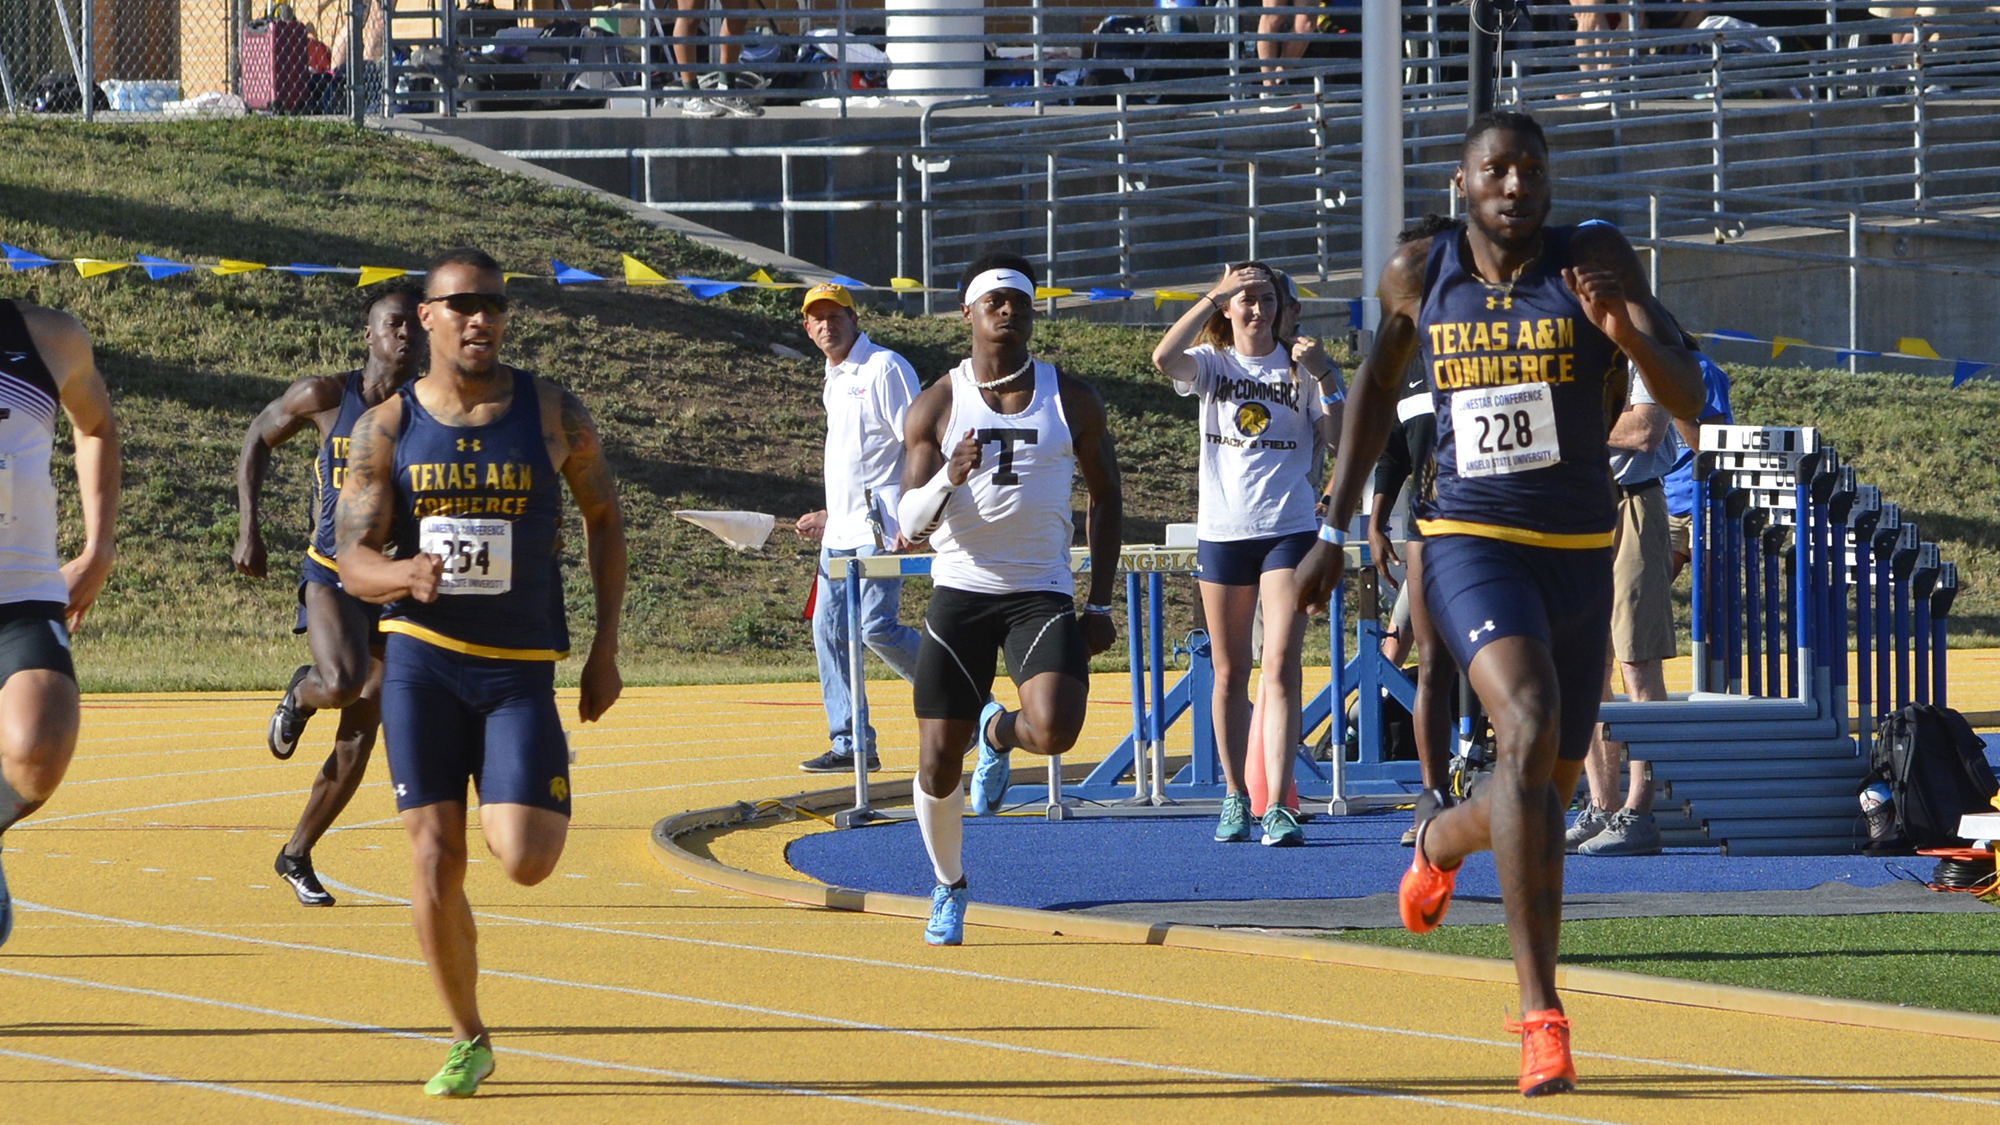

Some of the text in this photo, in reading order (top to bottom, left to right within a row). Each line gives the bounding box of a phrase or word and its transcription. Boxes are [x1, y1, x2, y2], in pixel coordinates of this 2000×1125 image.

[1429, 318, 1574, 355] TEXAS A&M
[1433, 354, 1575, 390] COMMERCE
[1494, 390, 1543, 407] CONFERENCE
[1206, 433, 1244, 449] TRACK
[1261, 440, 1298, 450] FIELD
[1474, 409, 1533, 454] 228
[1742, 431, 1770, 450] UCS
[977, 428, 1038, 486] T
[1466, 450, 1552, 471] ANGELO STATE UNIVERSITY
[408, 463, 532, 492] TEXAS A&M
[441, 540, 490, 575] 254
[1117, 553, 1198, 571] NGELO
